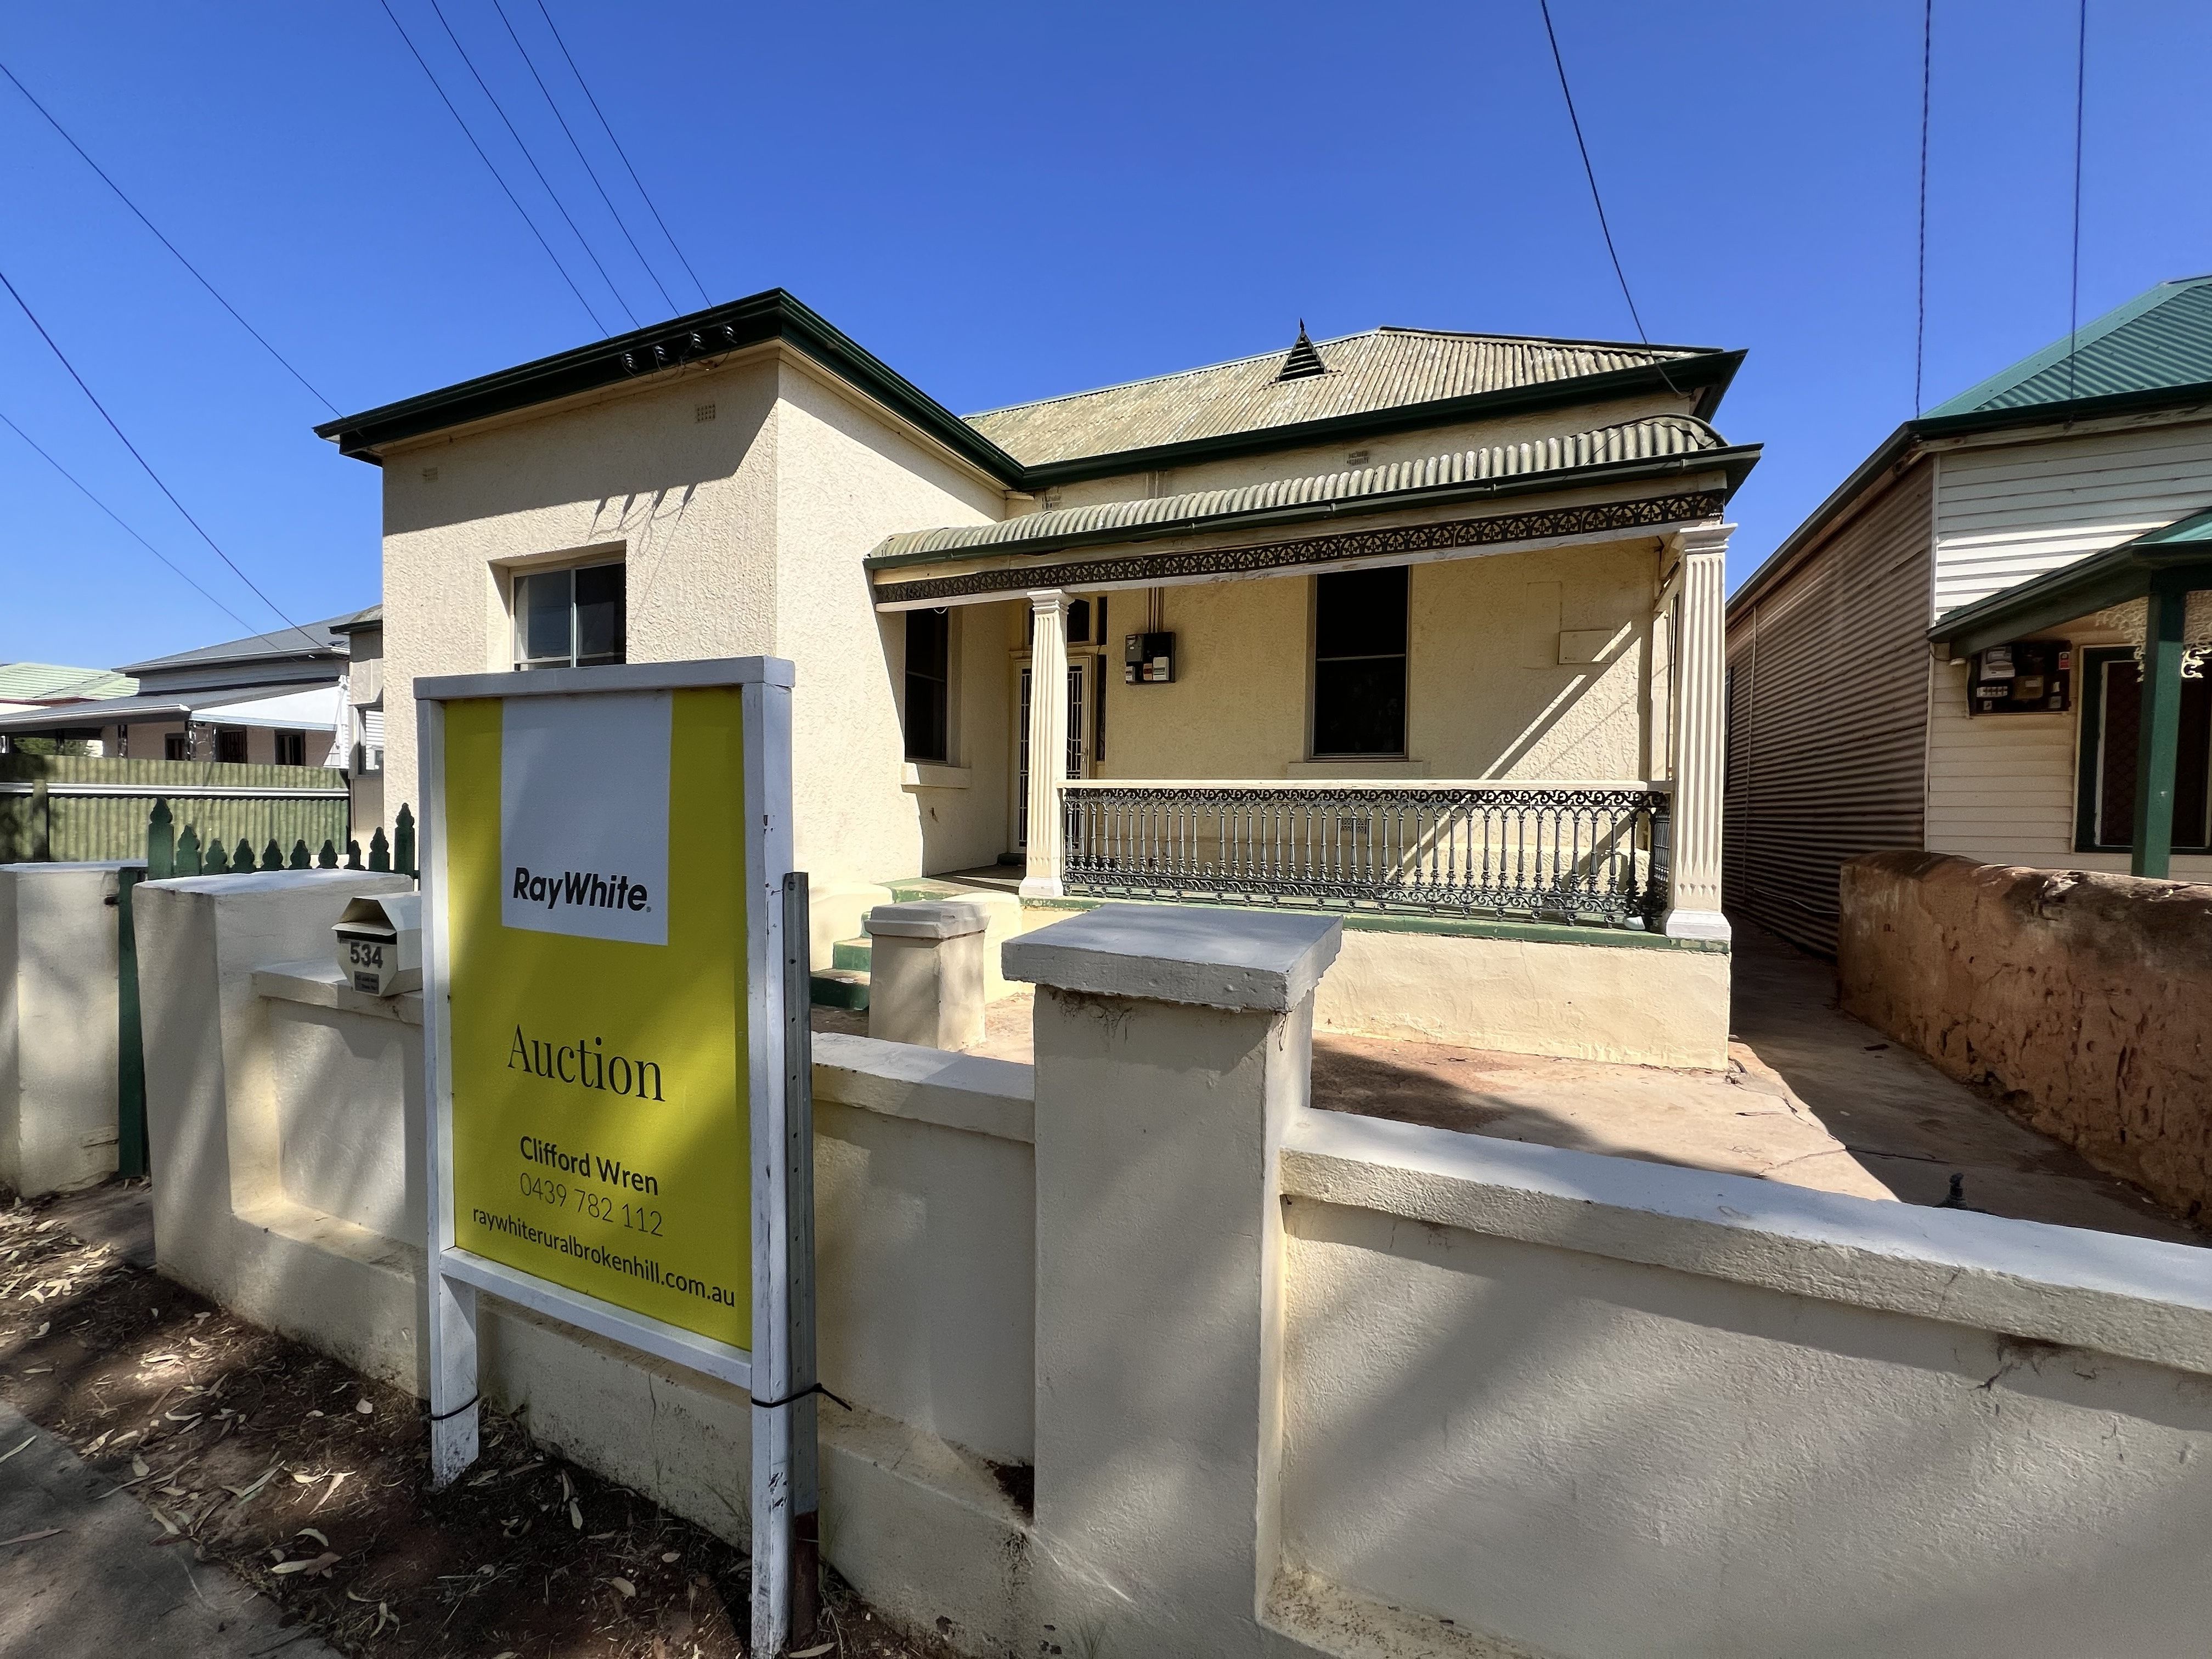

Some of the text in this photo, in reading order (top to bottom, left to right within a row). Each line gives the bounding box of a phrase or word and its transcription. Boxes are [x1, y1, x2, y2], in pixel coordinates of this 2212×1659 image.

[350, 941, 383, 969] 534
[507, 1024, 665, 1102] Auction
[520, 1136, 658, 1196] Clifford Wren
[520, 1172, 663, 1237] 0439 782 112
[473, 1207, 735, 1307] raywhiteruralbrokenhill.com.au
